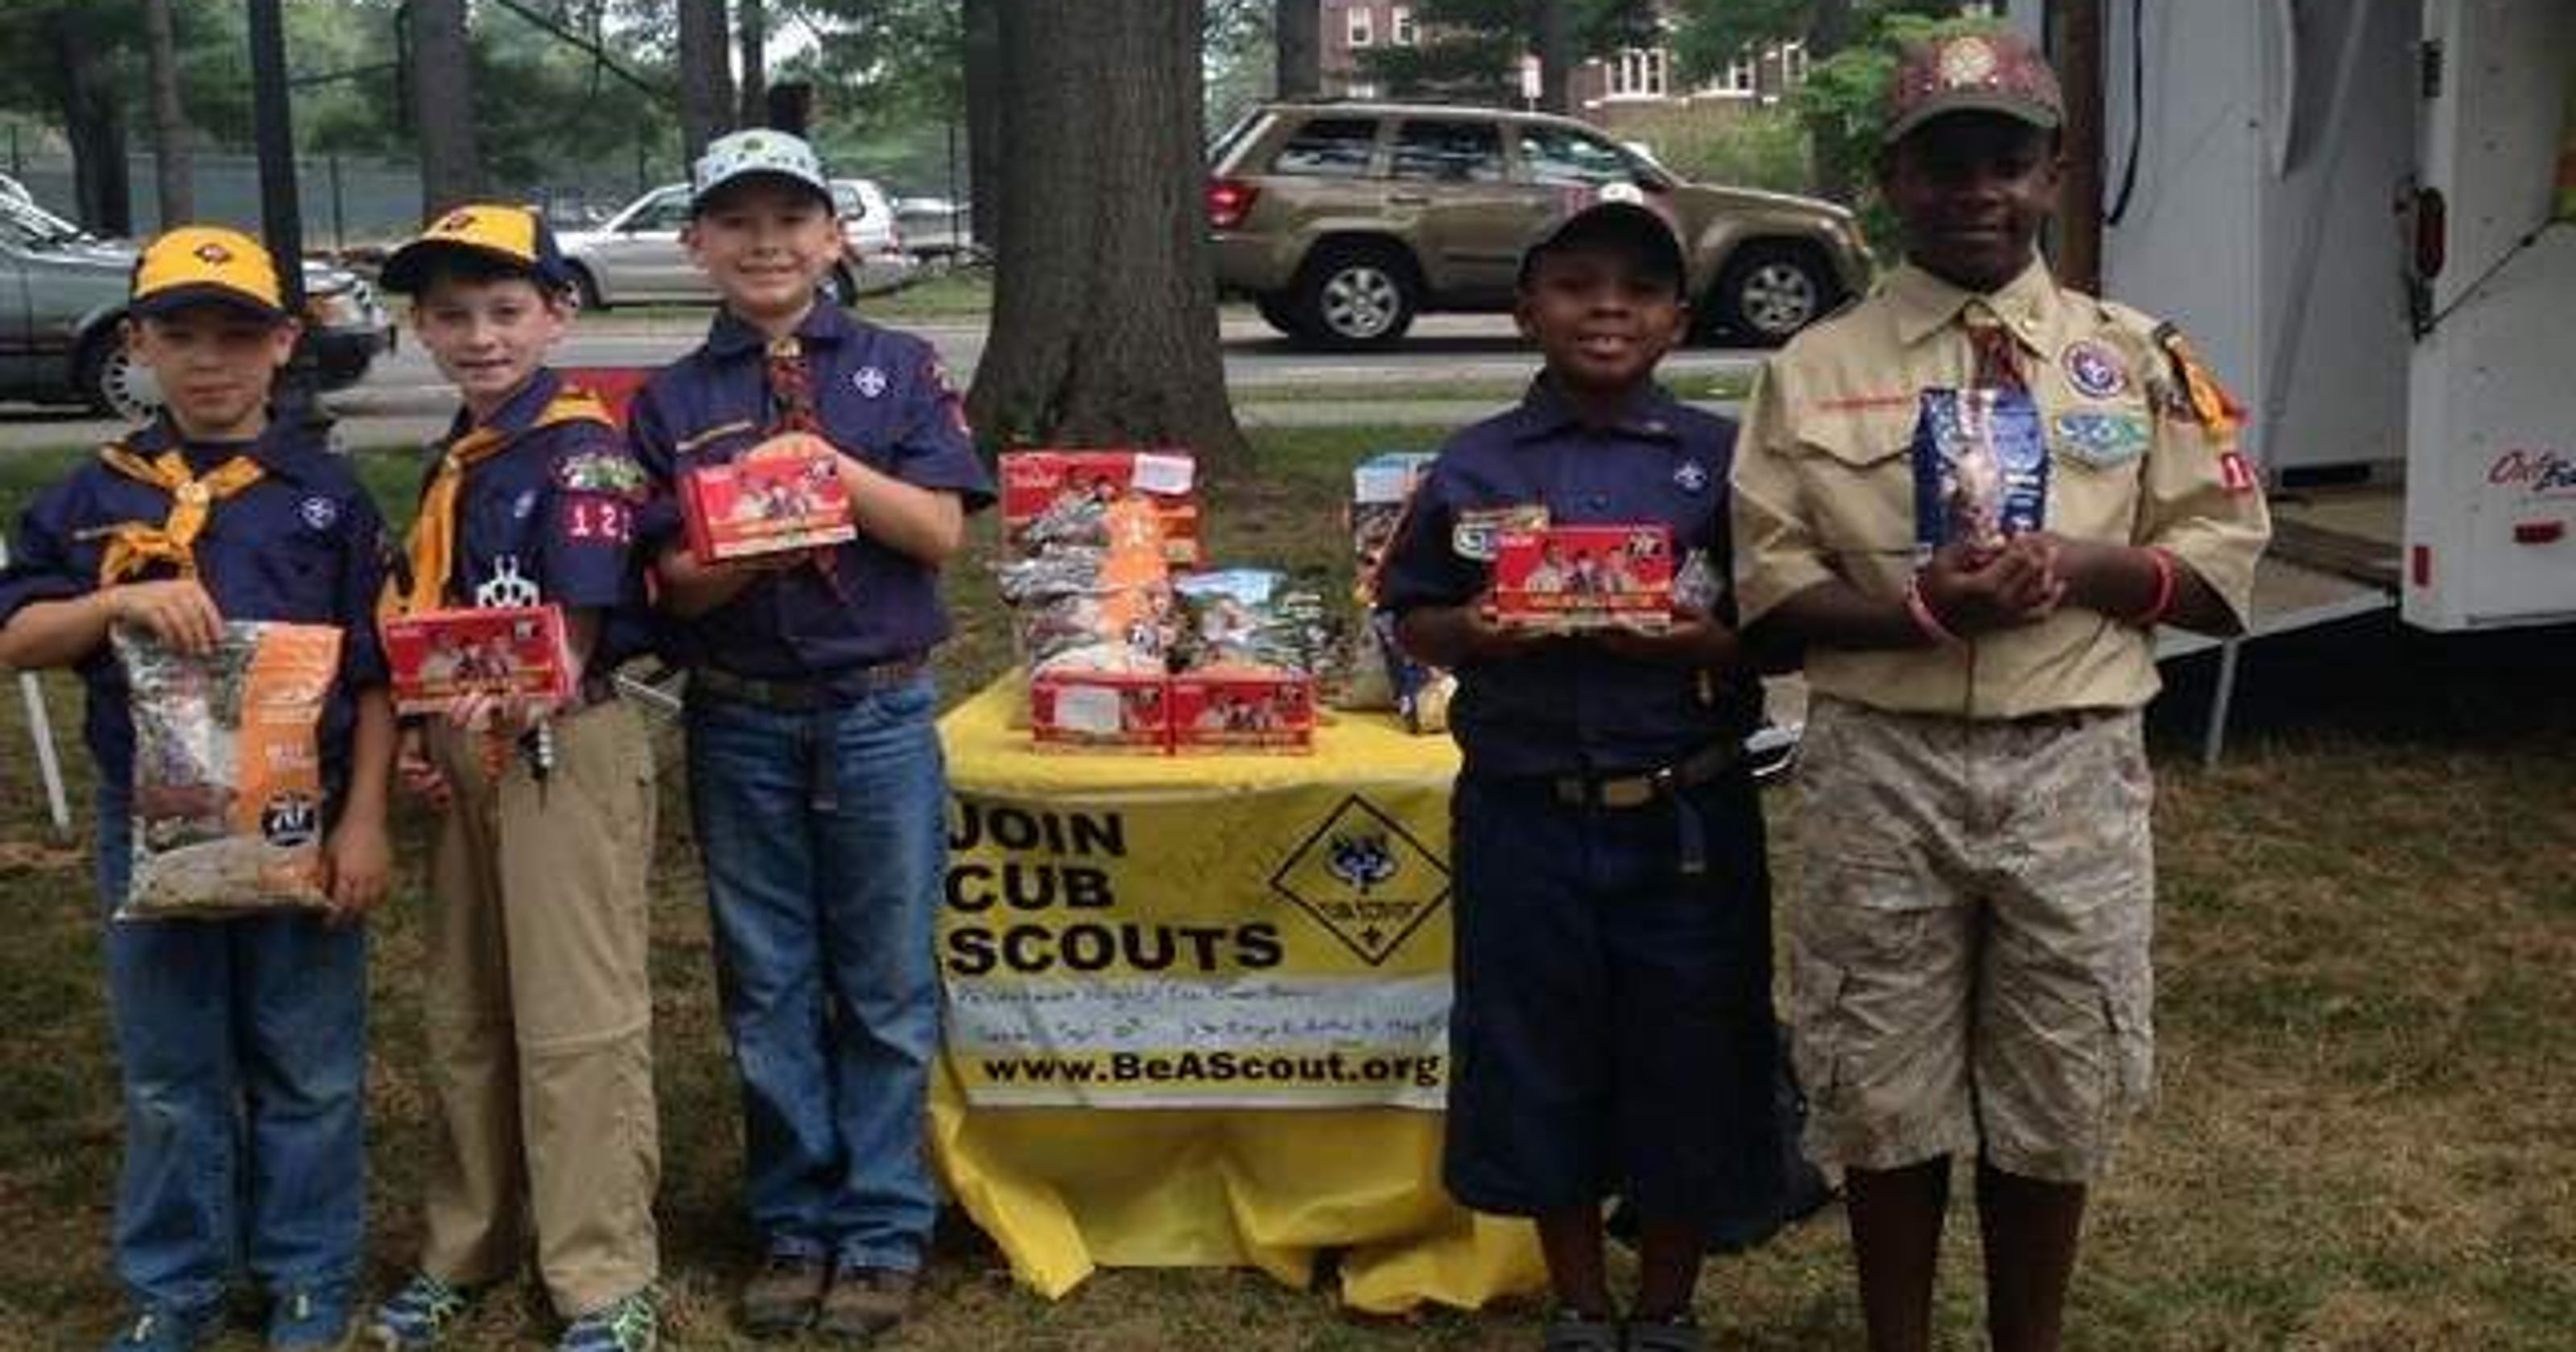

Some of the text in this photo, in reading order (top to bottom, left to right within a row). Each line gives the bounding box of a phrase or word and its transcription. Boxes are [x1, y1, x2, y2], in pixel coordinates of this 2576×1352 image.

[948, 803, 1126, 857] JOIN
[946, 864, 1116, 911] CUB
[947, 922, 1284, 975] SCOUTS
[984, 1052, 1440, 1087] www.BeAScout.org
